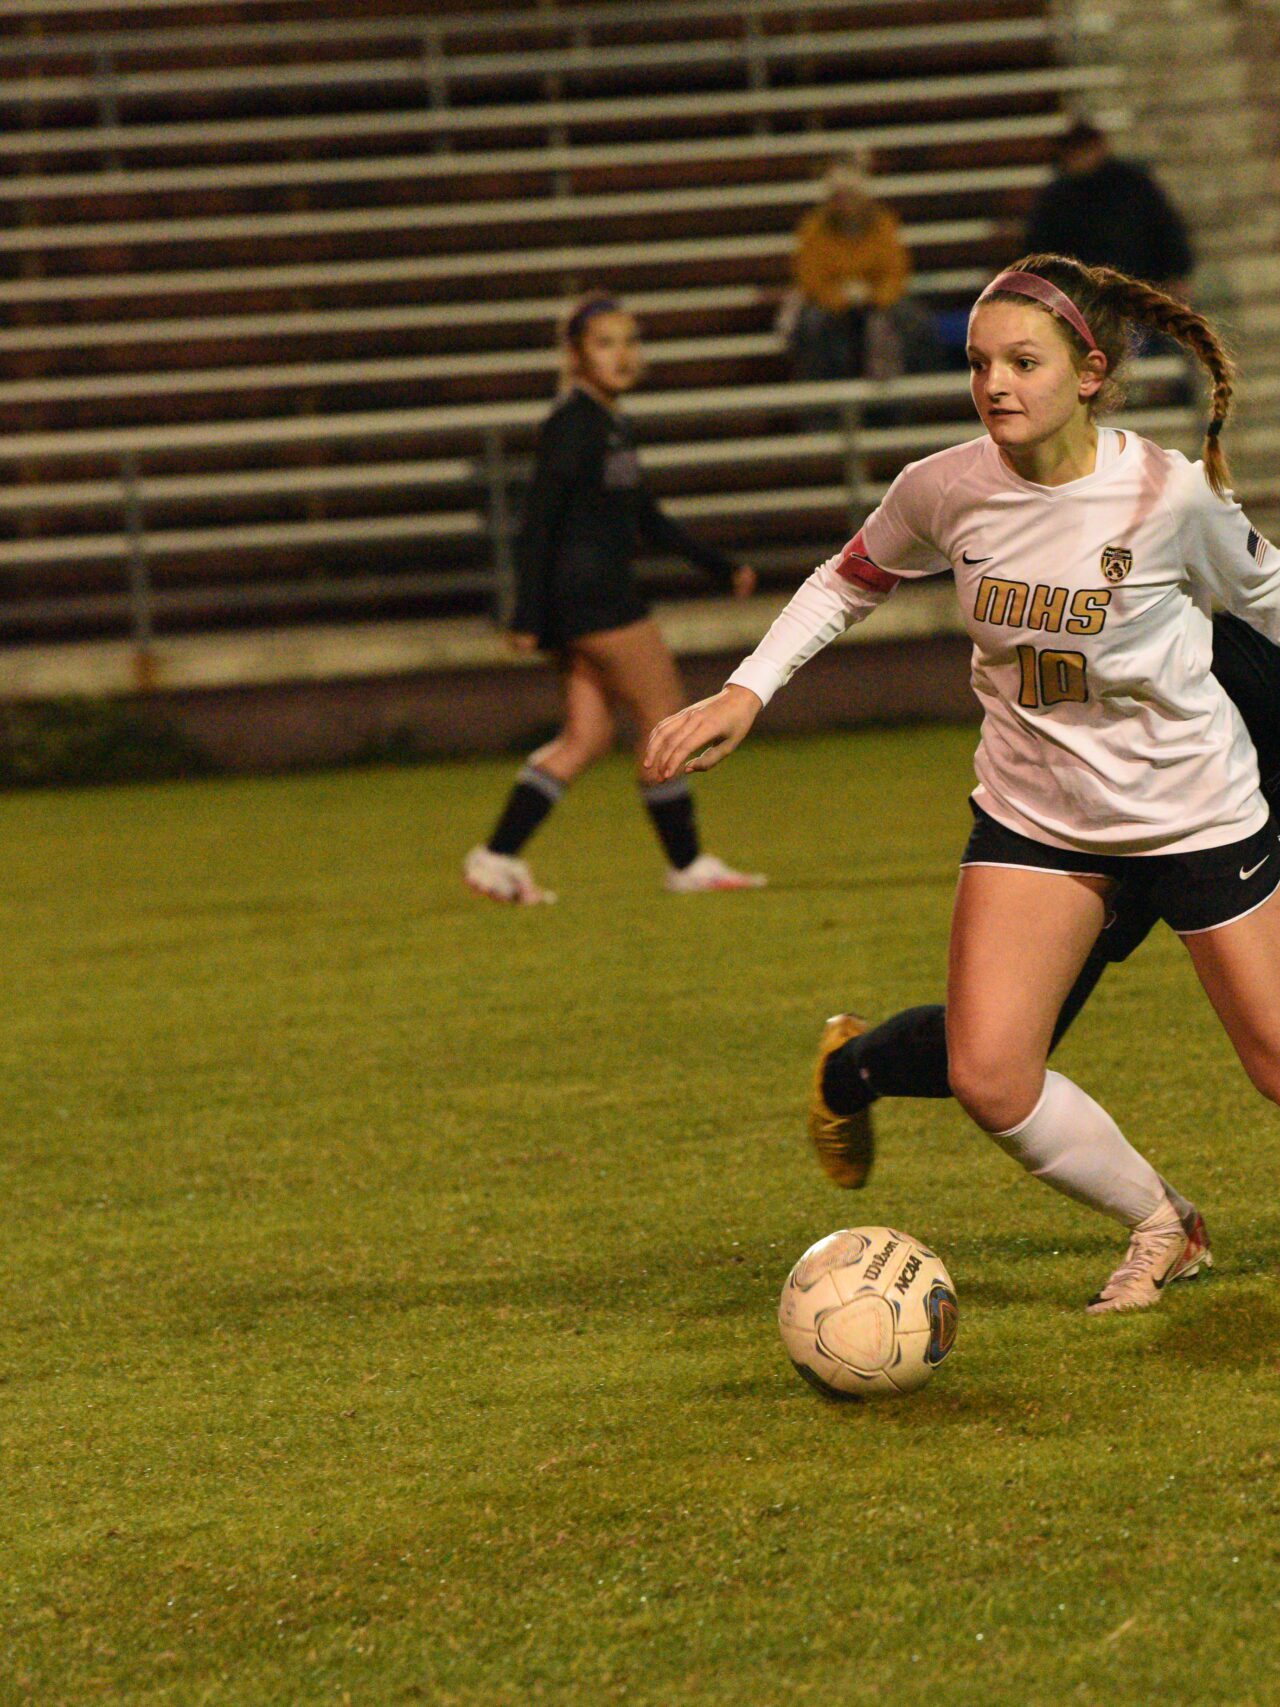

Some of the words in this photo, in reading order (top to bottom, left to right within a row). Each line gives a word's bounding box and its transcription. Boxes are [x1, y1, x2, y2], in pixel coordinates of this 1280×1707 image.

[974, 576, 1111, 635] MHS
[1016, 645, 1088, 708] 10
[864, 1240, 899, 1281] Wilson
[895, 1255, 922, 1295] NCAA
